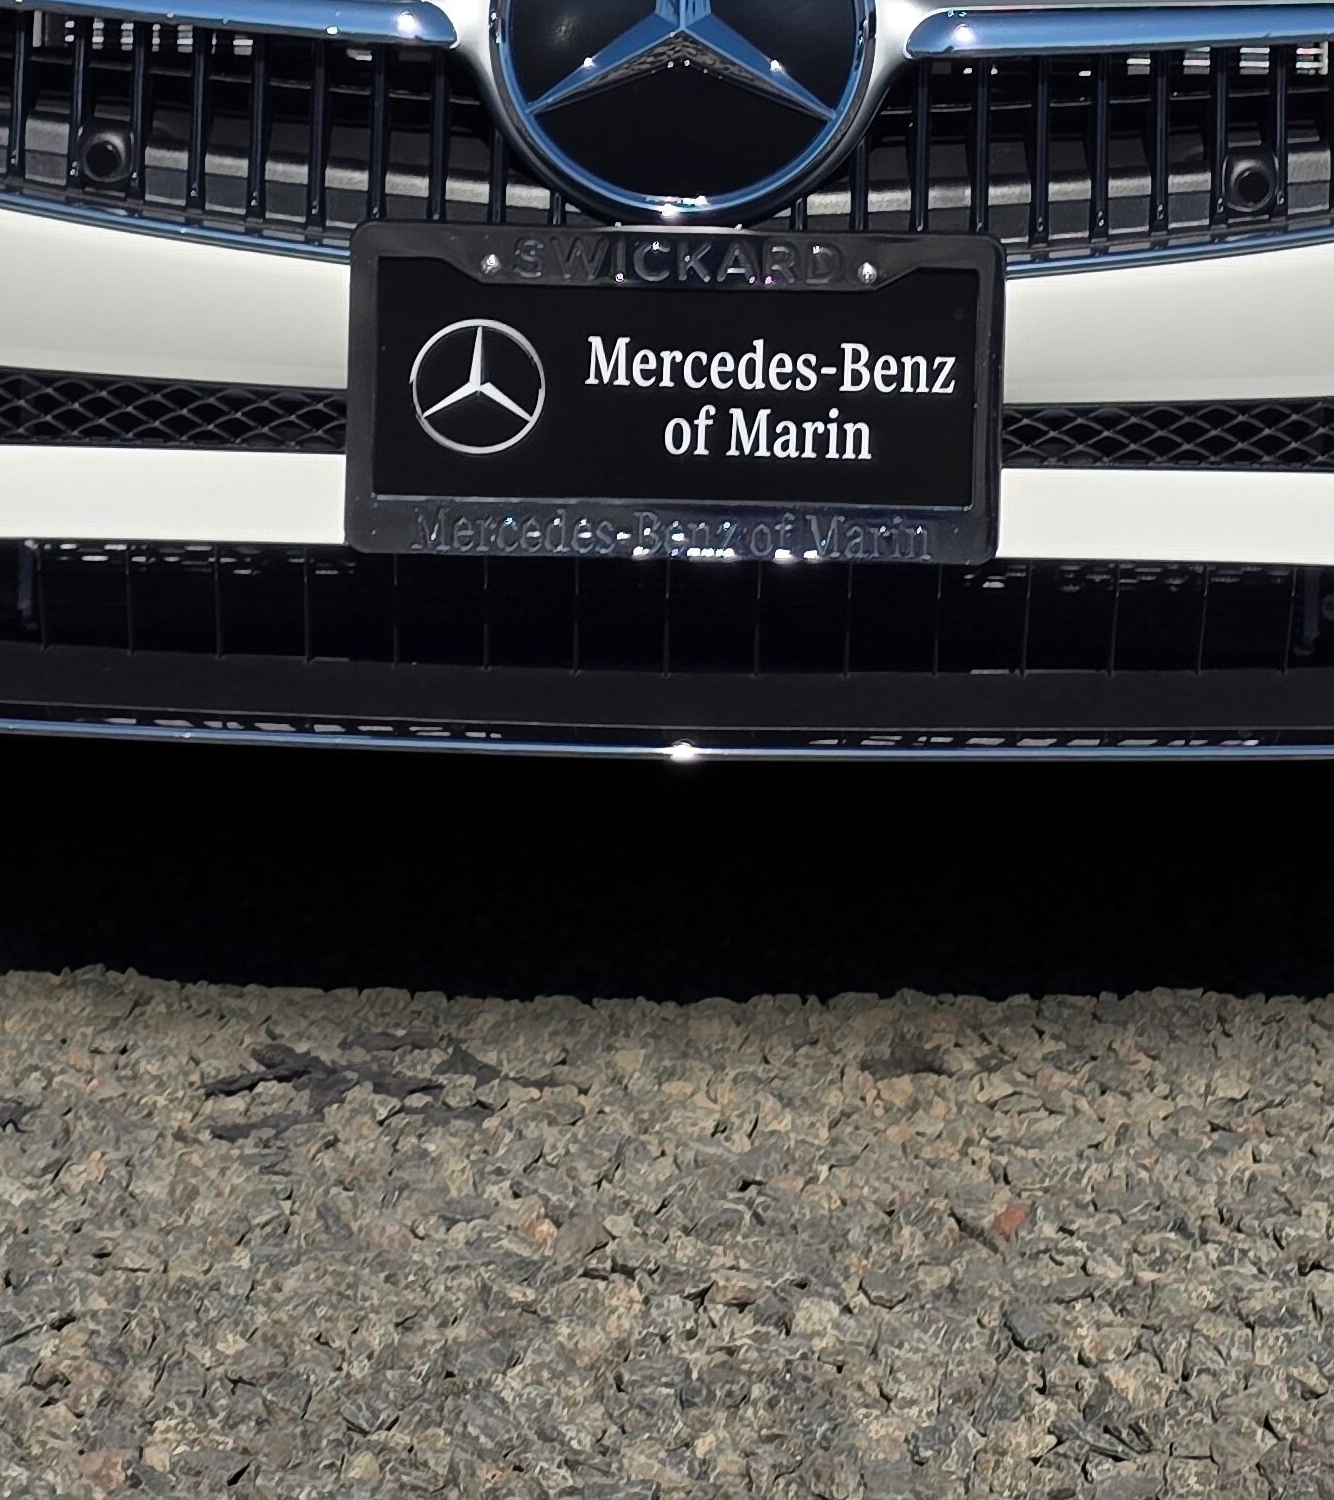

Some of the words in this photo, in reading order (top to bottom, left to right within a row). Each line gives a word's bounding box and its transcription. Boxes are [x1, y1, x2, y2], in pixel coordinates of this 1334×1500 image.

[513, 235, 844, 285] SWICKARD
[584, 335, 957, 395] Mercedes-Benz
[663, 404, 716, 457] of
[726, 407, 873, 461] Marin
[410, 508, 740, 559] Mercedes-Benz
[750, 512, 797, 560] of
[803, 514, 932, 561] Marin
